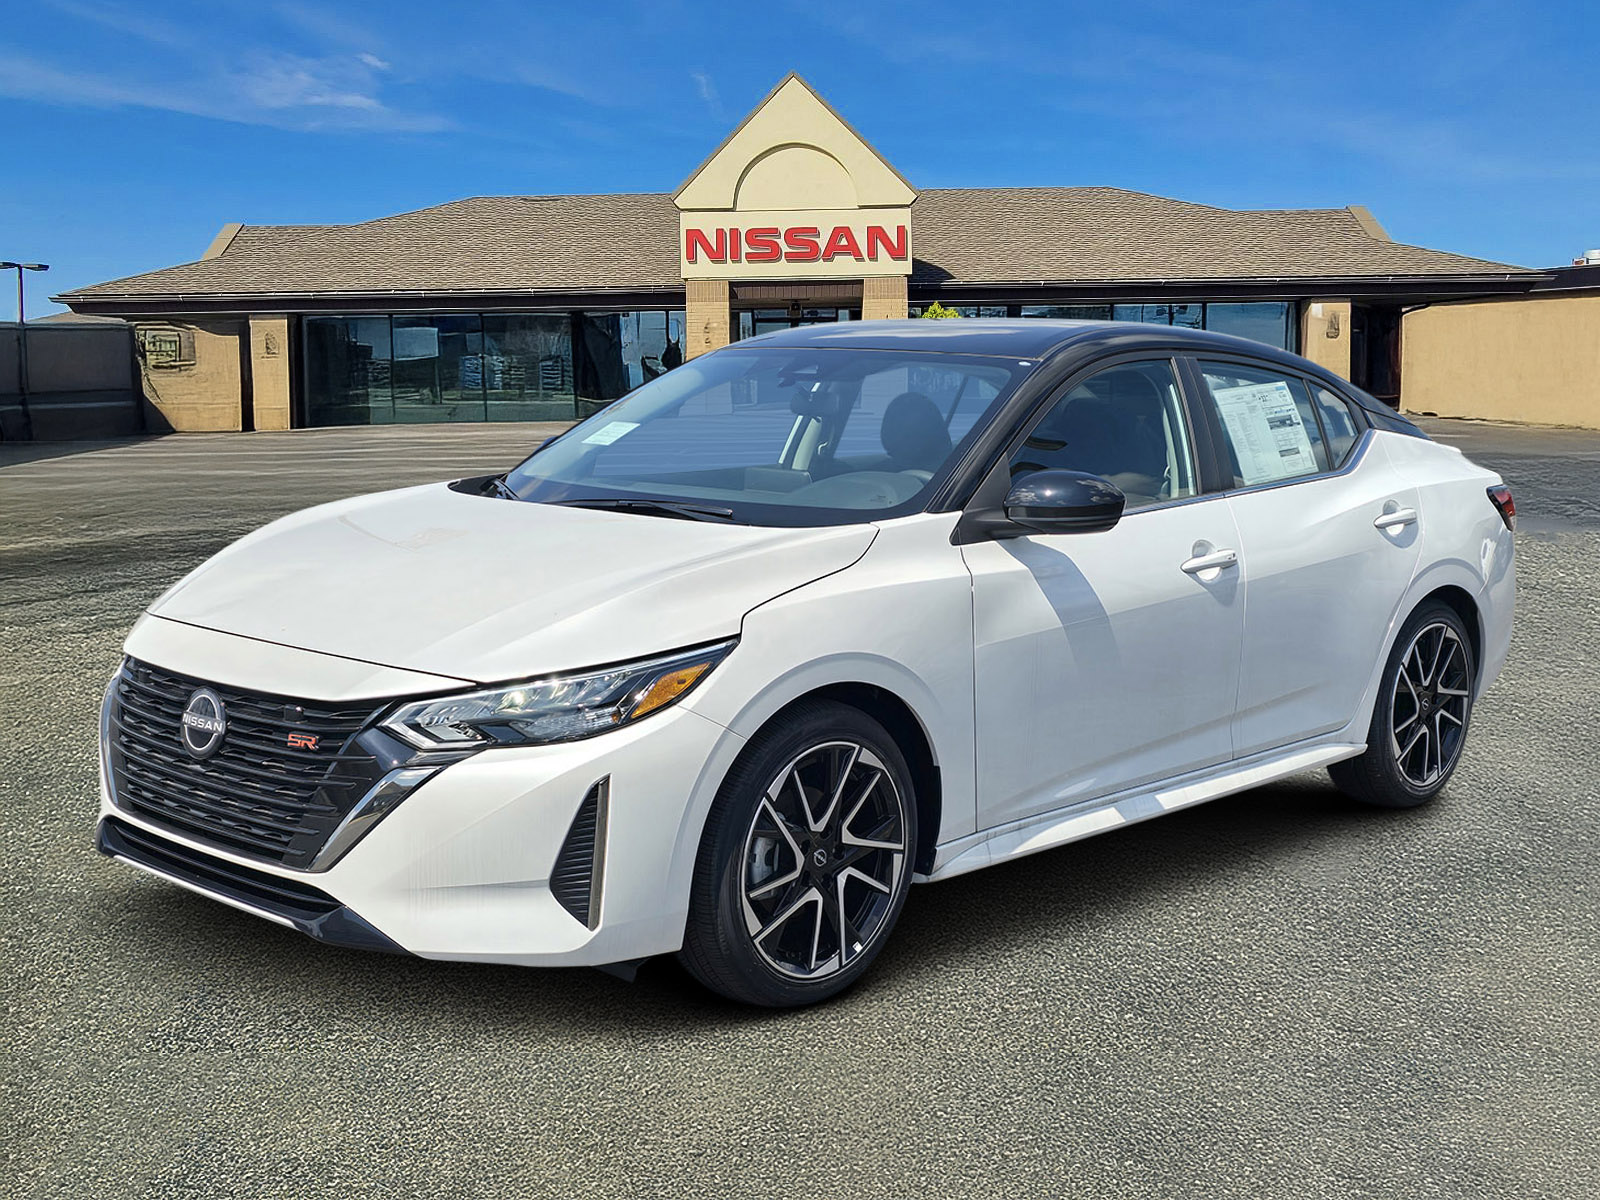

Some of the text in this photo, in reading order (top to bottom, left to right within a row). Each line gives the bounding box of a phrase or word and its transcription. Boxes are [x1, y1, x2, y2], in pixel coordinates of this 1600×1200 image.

[685, 225, 908, 264] NISSAN
[182, 712, 223, 732] NISSAN
[287, 733, 317, 750] SR
